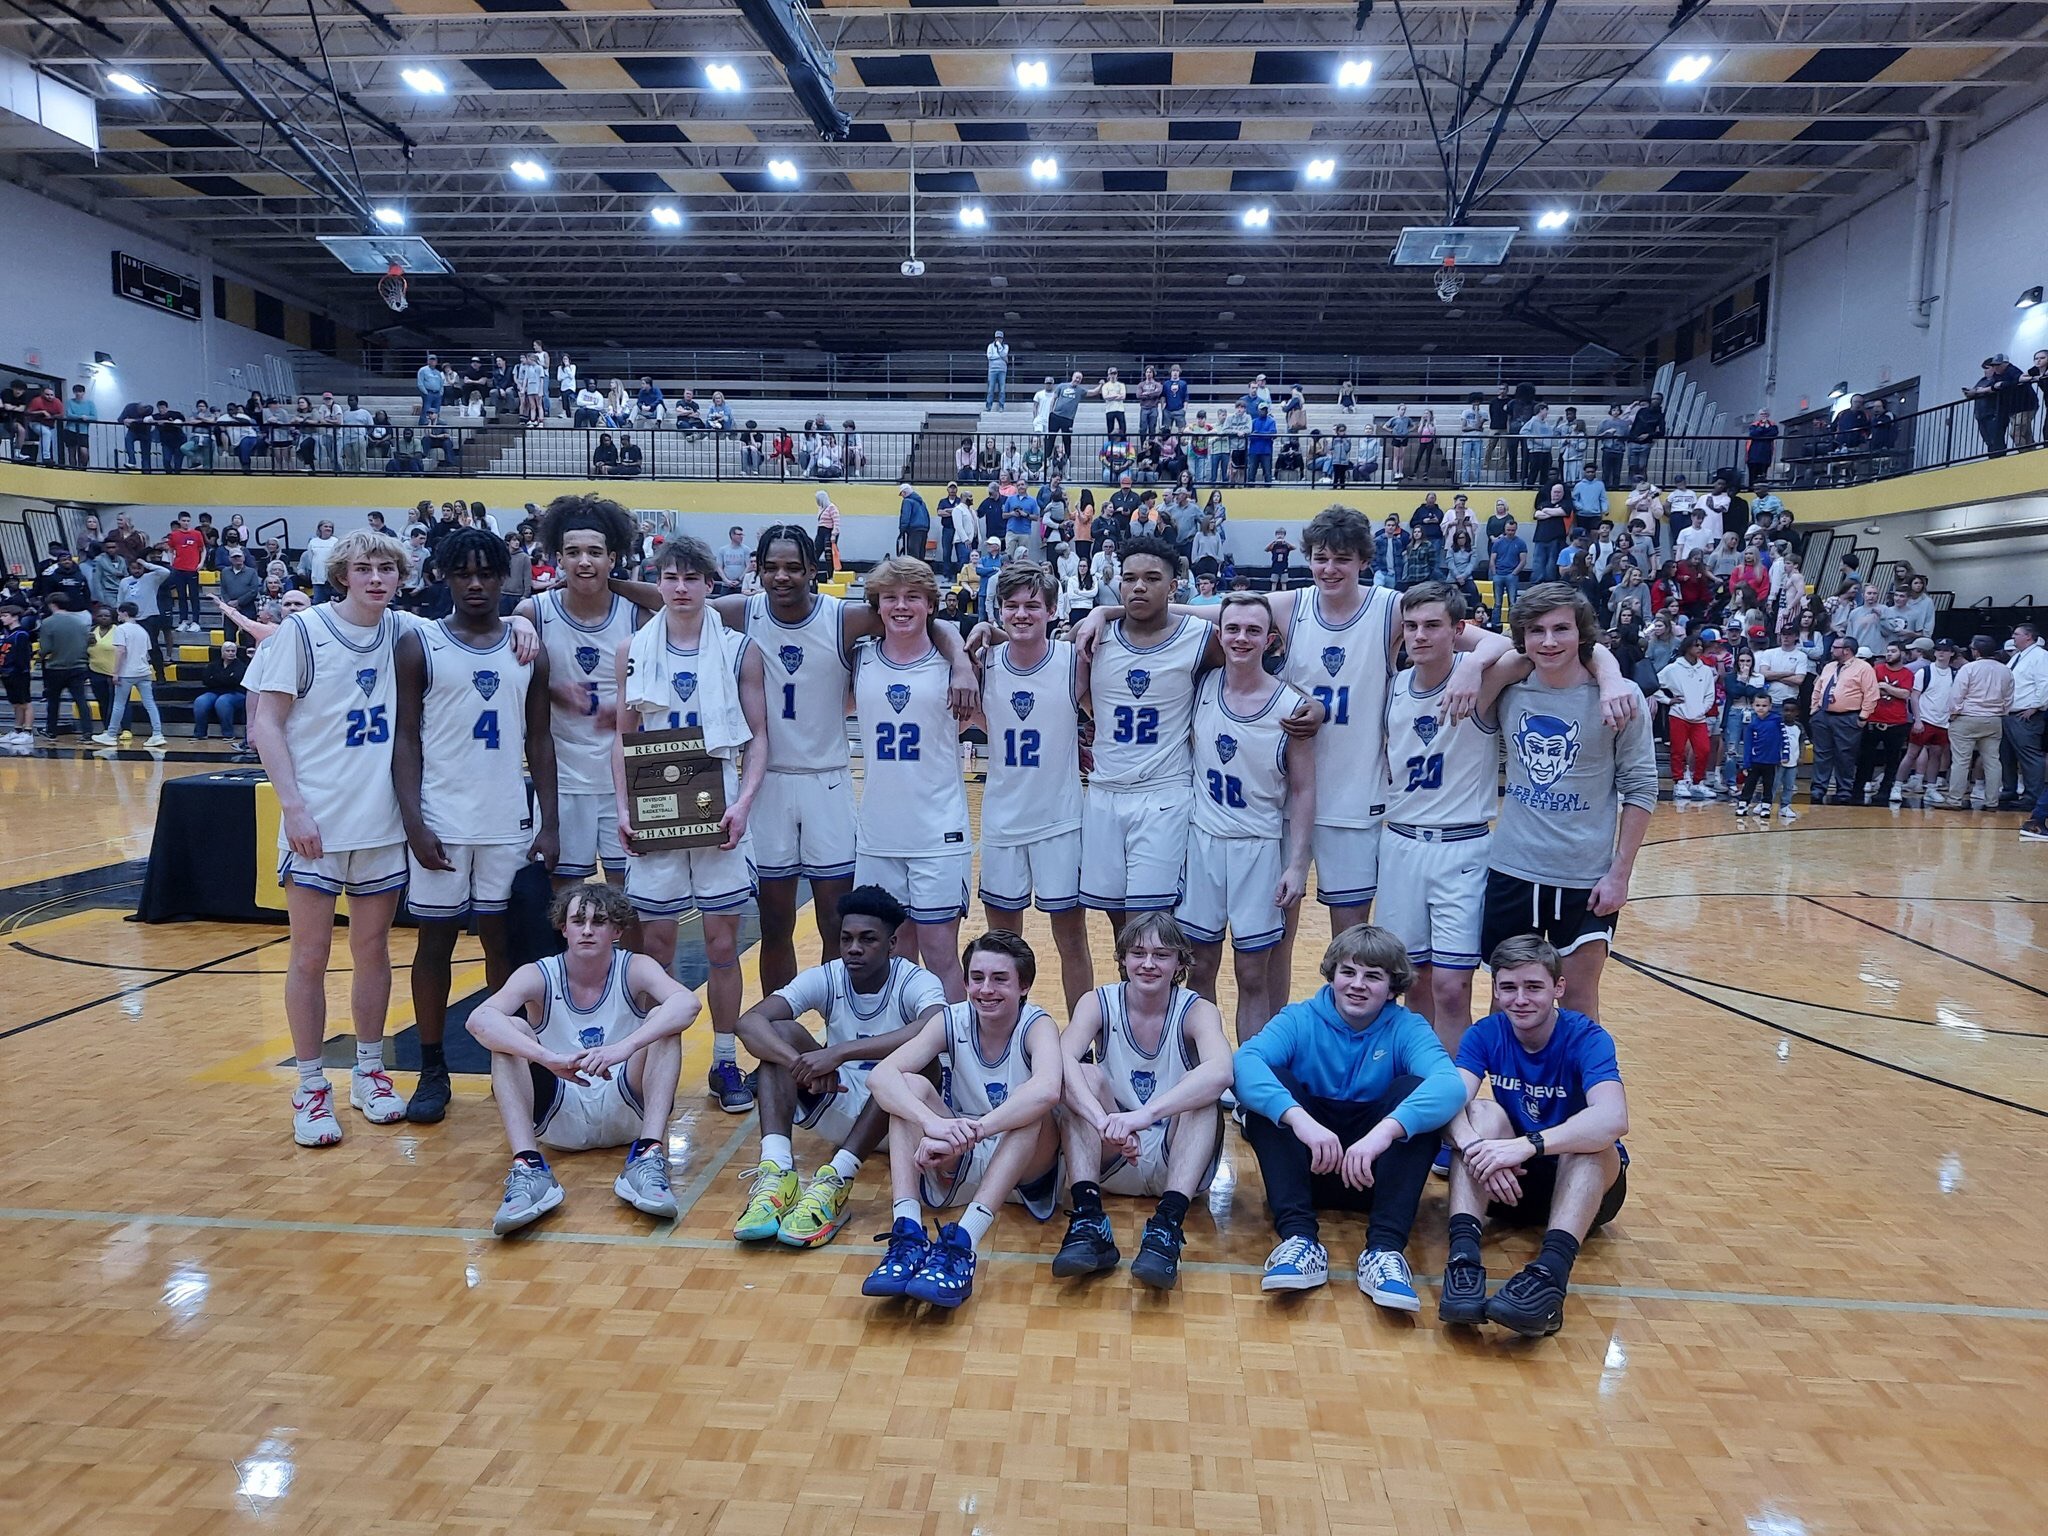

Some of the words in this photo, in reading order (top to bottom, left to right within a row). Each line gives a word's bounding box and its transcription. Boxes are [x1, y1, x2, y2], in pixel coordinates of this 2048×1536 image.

[781, 683, 797, 720] 1
[1312, 684, 1351, 726] 31
[345, 703, 390, 748] 25
[472, 709, 501, 751] 4
[875, 722, 921, 762] 22
[1113, 705, 1160, 745] 32
[1004, 729, 1041, 768] 12
[1206, 768, 1248, 809] 30
[1513, 793, 1591, 812] KETBALL
[637, 823, 722, 839] CHAMPIONS
[1490, 1074, 1521, 1091] BLUE
